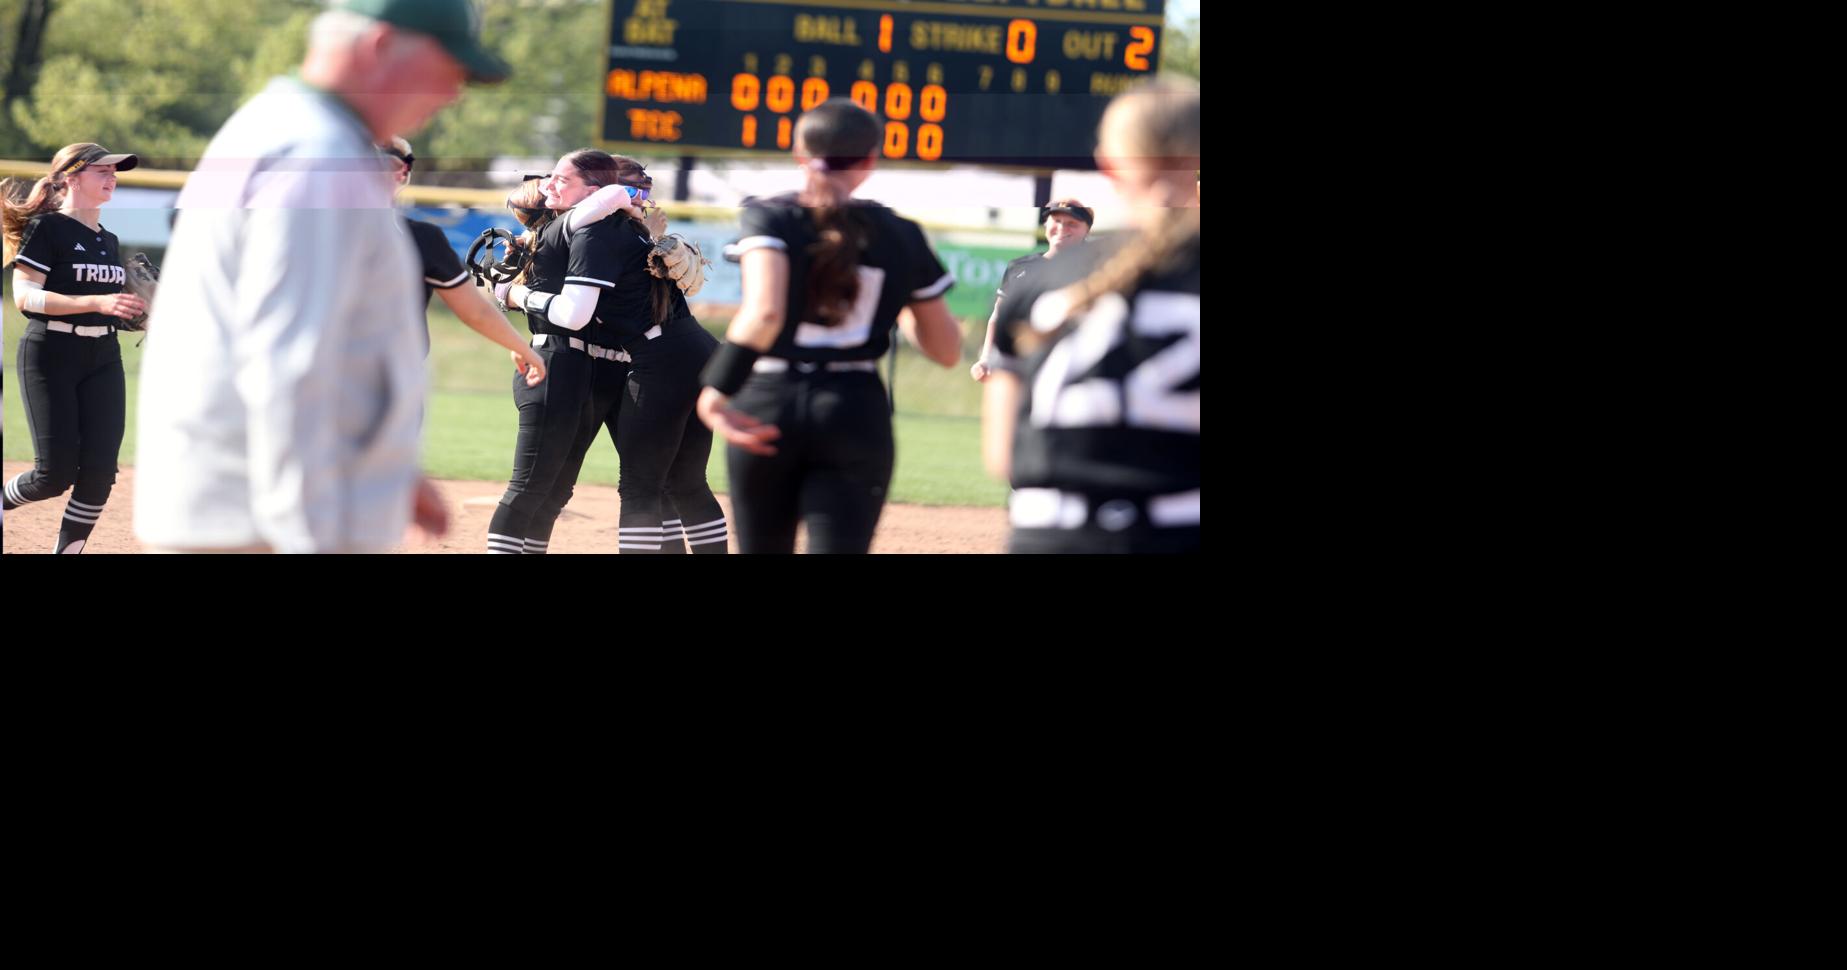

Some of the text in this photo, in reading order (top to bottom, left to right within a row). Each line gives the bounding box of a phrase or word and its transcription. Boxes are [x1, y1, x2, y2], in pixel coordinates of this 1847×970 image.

[794, 14, 1155, 70] BALL 1 STRIKE 0 OUT 2
[607, 68, 707, 104] ALPENA
[977, 65, 993, 90] 7
[626, 108, 683, 141] TCC
[1030, 290, 1199, 430] 22
